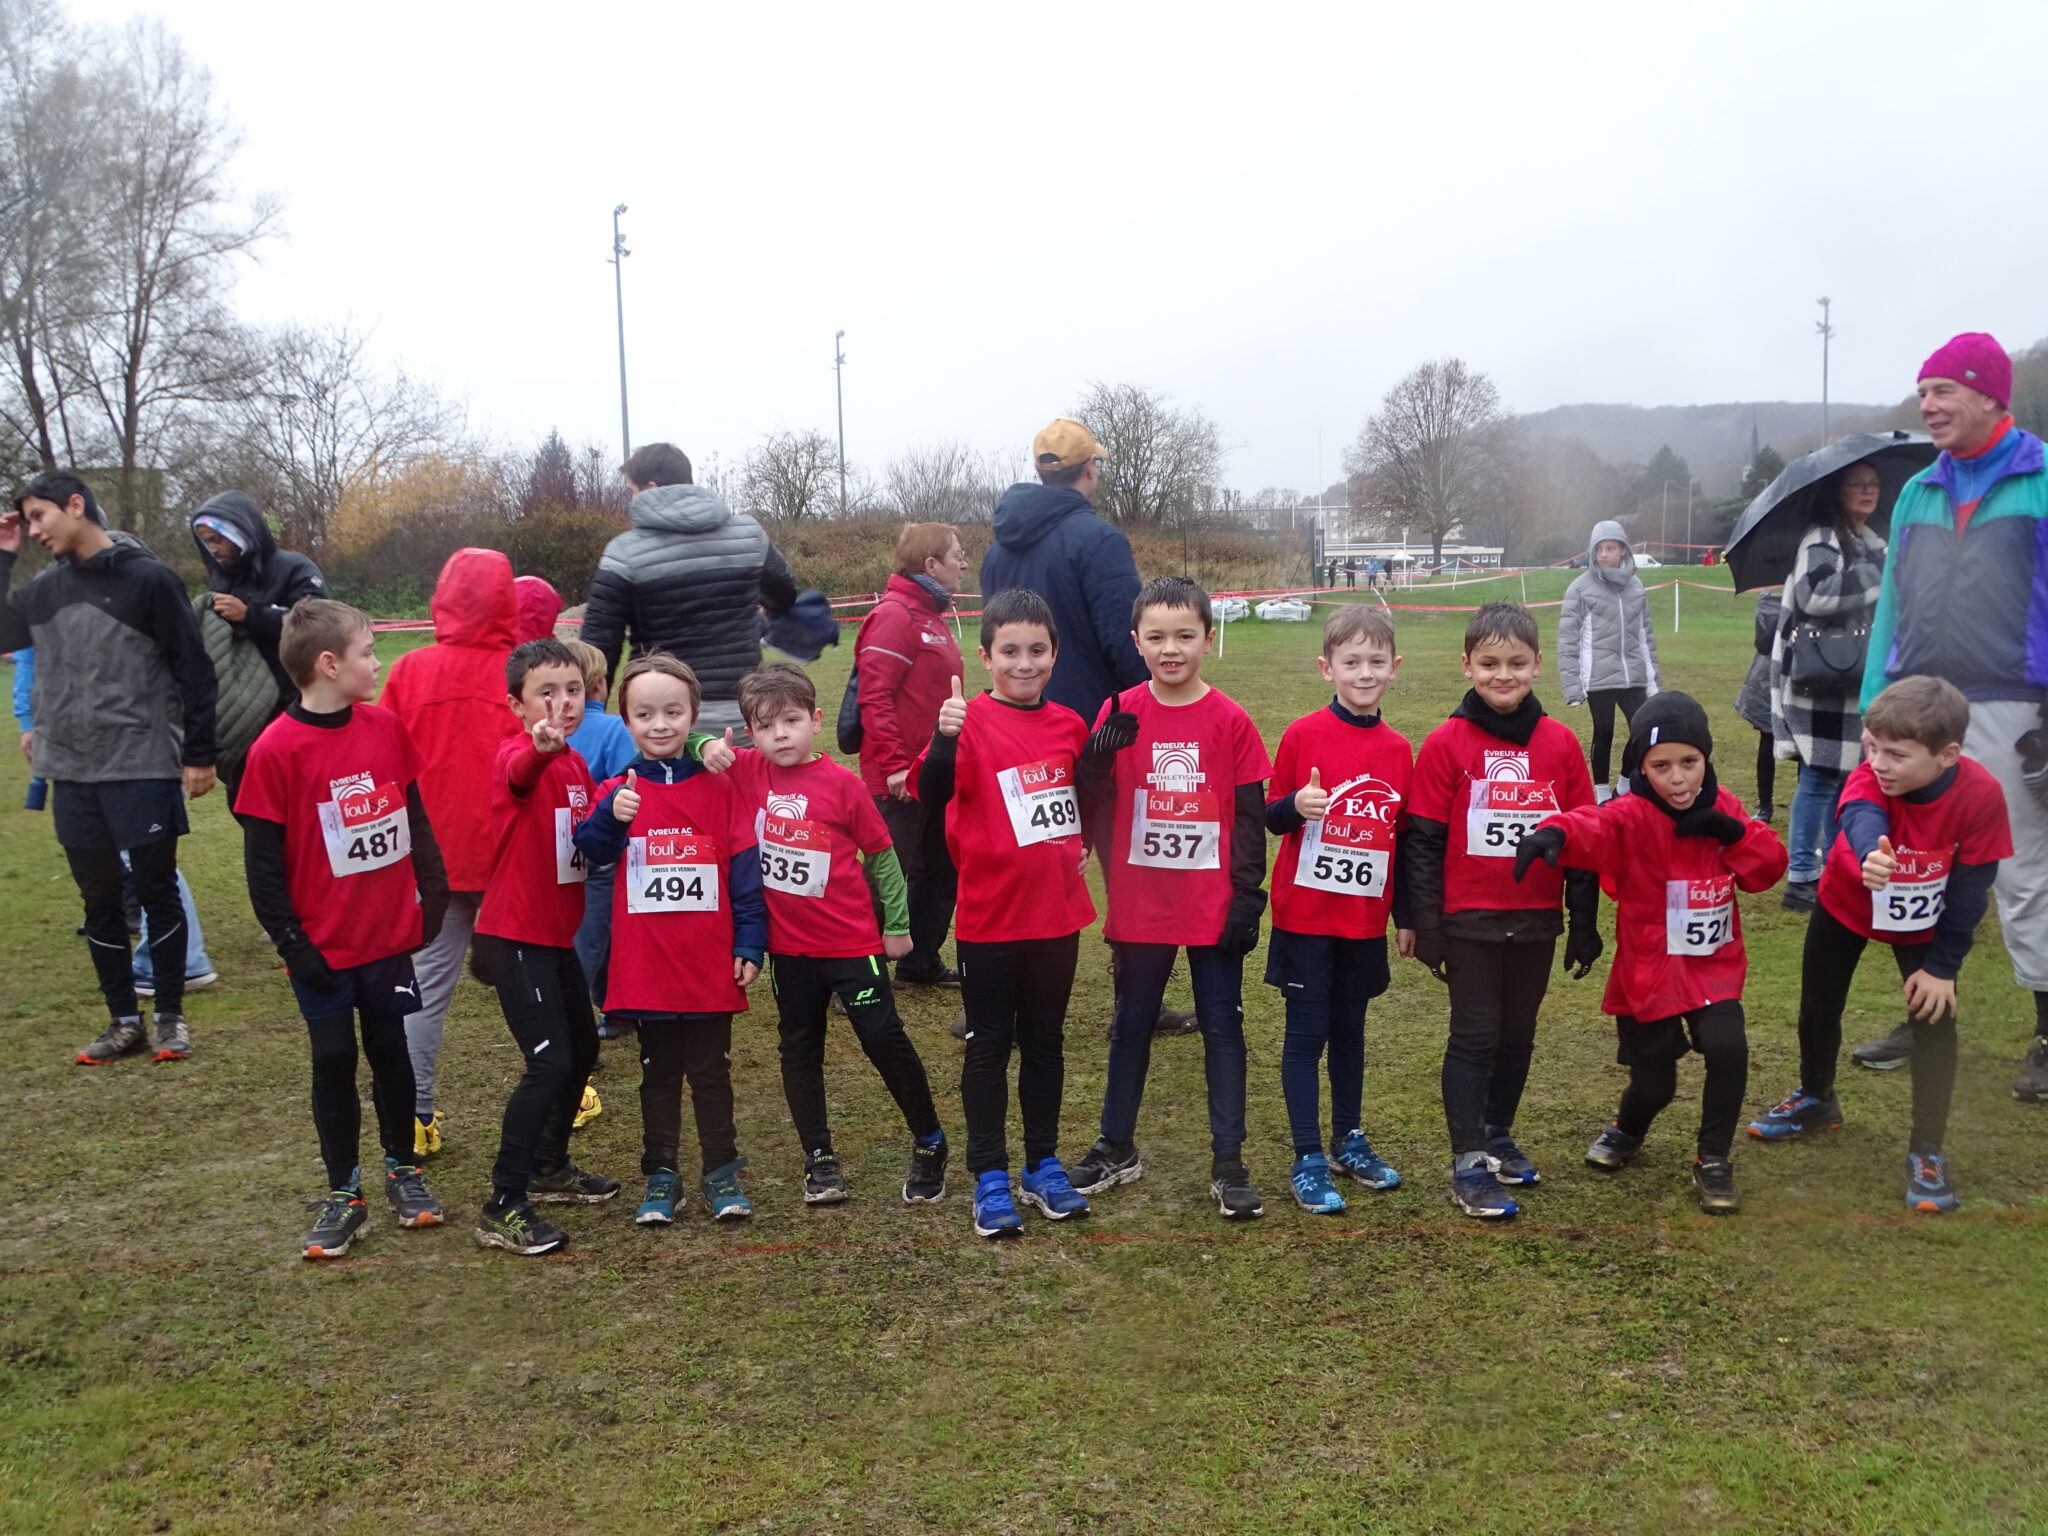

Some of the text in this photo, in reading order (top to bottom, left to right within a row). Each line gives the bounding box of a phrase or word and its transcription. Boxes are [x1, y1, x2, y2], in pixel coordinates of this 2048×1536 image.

[1152, 741, 1185, 749] ÉVREUX
[1484, 749, 1516, 757] ÉVREUX
[329, 770, 371, 788] ÉVREUX AC
[1149, 774, 1204, 782] ATHLÉTISME
[1032, 792, 1048, 800] CROSS
[1030, 799, 1076, 828] 489
[1344, 798, 1390, 824] EAC
[348, 824, 398, 861] 487
[648, 828, 680, 836] ÉVREUX
[786, 847, 806, 857] VERNON
[1143, 832, 1203, 859] 537
[1324, 846, 1341, 854] CROSS
[1350, 849, 1370, 857] VERNON
[760, 851, 810, 886] 535
[1314, 855, 1374, 886] 536
[644, 876, 704, 902] 494
[1889, 890, 1945, 920] 522
[1686, 914, 1728, 946] 521
